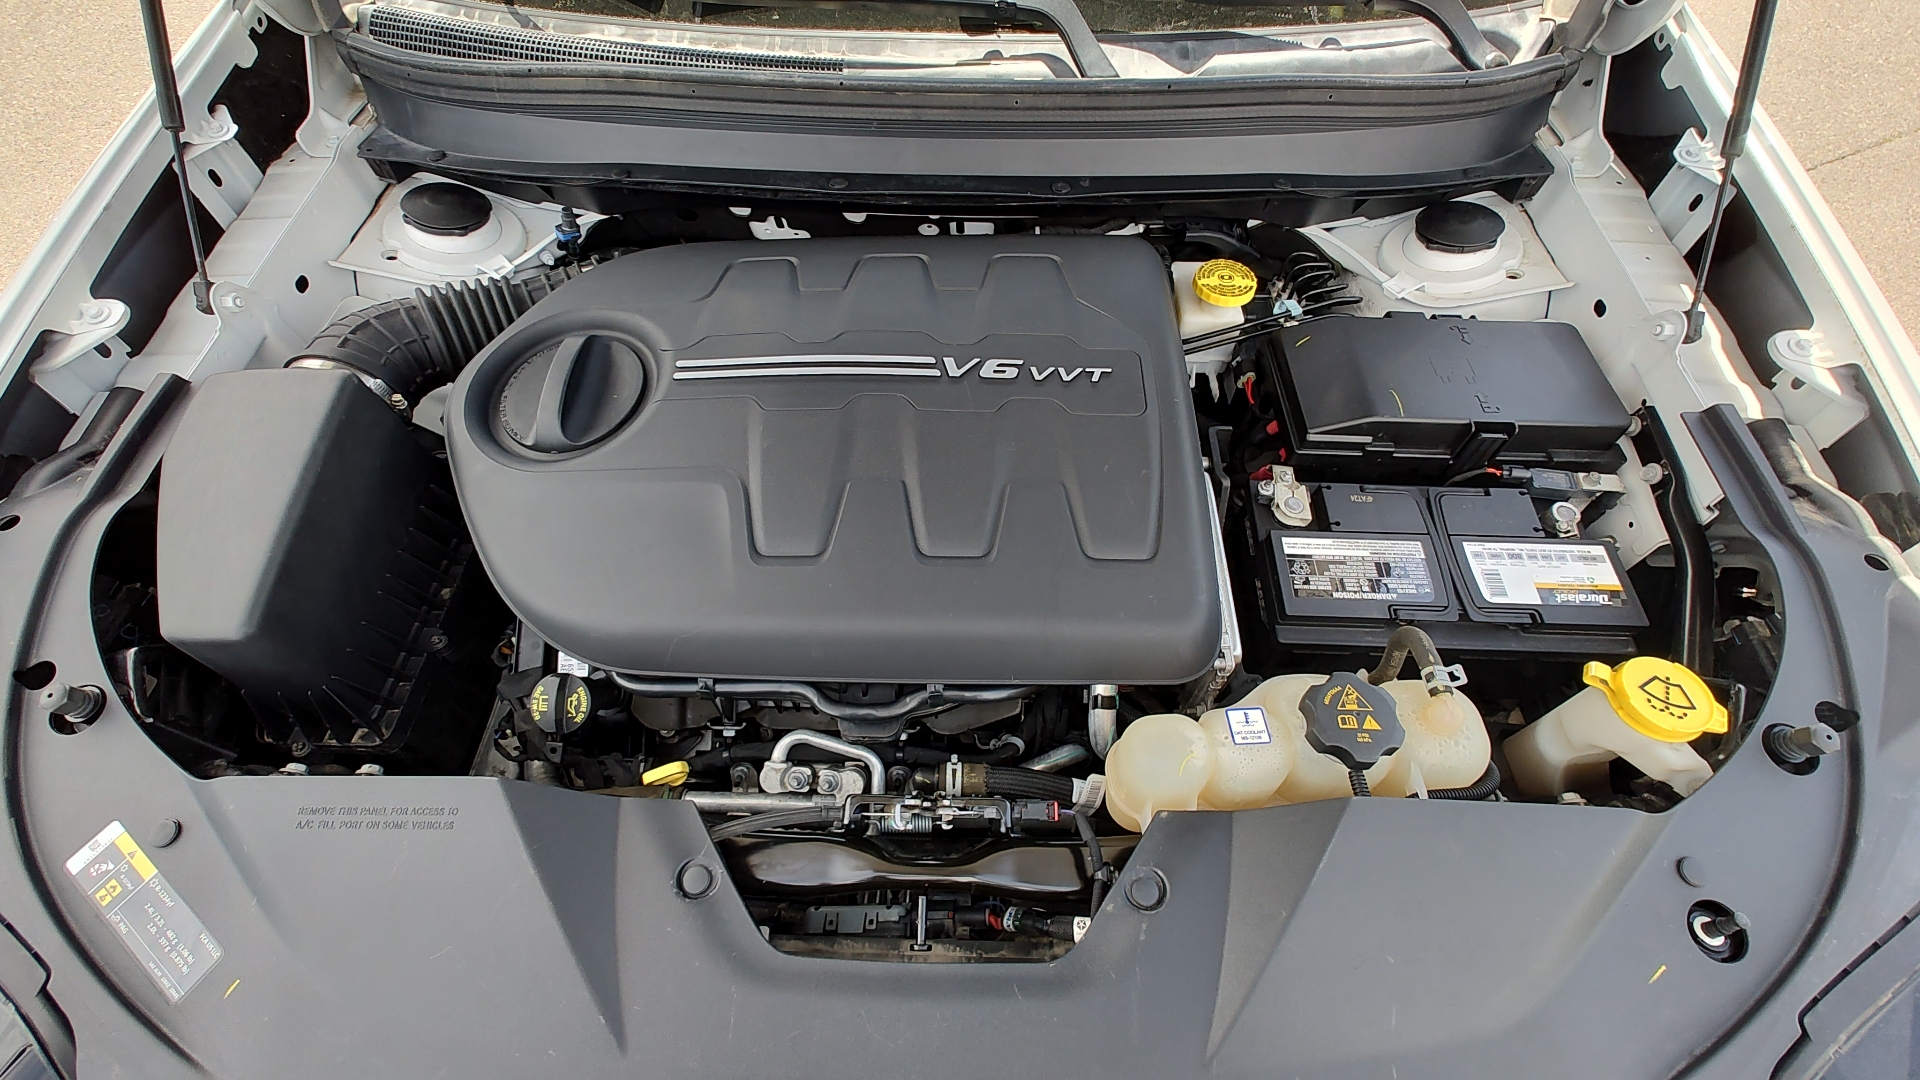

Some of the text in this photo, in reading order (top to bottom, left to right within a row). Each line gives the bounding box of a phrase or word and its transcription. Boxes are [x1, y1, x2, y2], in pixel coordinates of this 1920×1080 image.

[942, 357, 1113, 382] V6 VVT
[1556, 593, 1613, 605] Duralast
[531, 685, 544, 721] SAE 5W-20
[573, 686, 588, 723] ENGINE OIL
[297, 806, 459, 816] REMOVE THIS PANEL FOR ACCESS TO
[295, 820, 455, 830] A/C FILL PORT ON SOME VEHICLES
[152, 883, 174, 909] R-1234yf
[117, 921, 128, 934] PAG
[143, 902, 155, 915] 2.4L
[153, 914, 165, 927] 3.2L
[176, 942, 190, 958] (1.06
[185, 953, 195, 965] lb)
[146, 922, 158, 935] 2.0L
[179, 964, 190, 976] lb)
[198, 933, 219, 959] FCA US LLC
